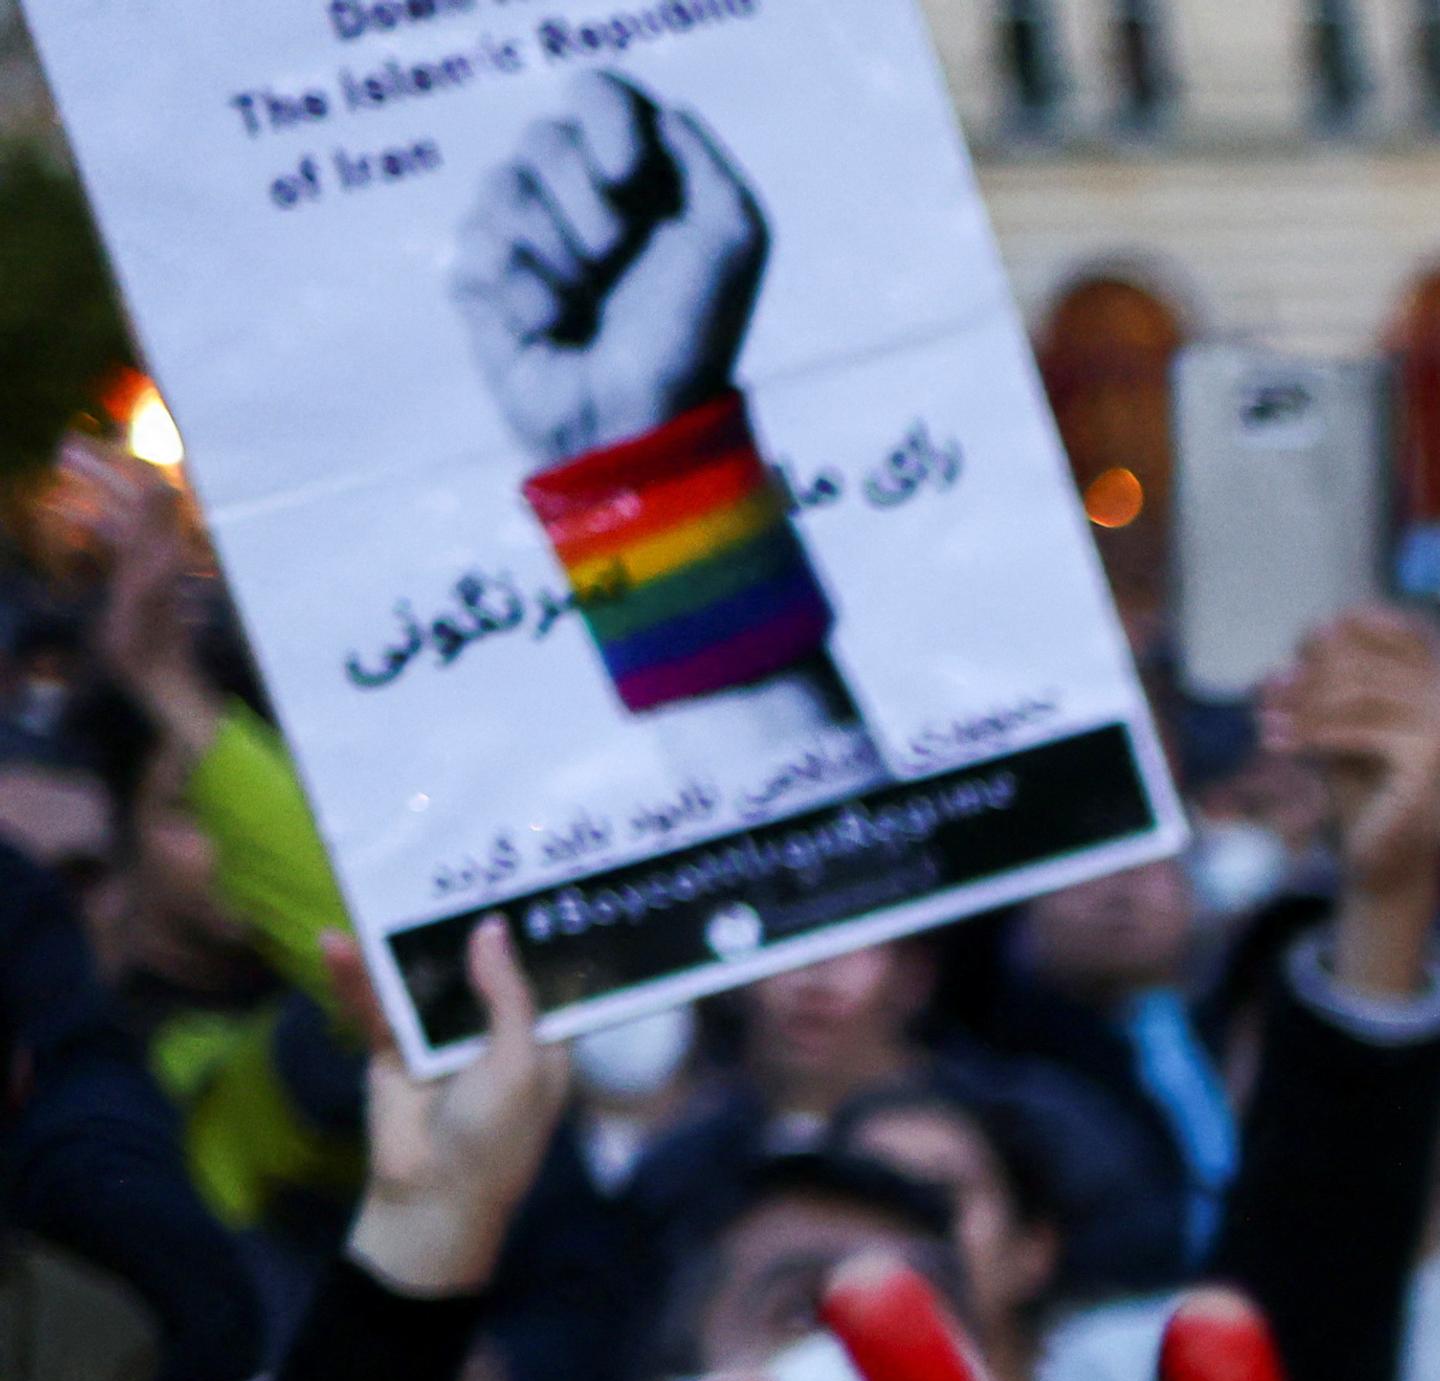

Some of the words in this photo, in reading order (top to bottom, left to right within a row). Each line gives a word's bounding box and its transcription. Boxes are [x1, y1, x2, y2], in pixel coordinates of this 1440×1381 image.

[229, 90, 329, 138] The
[333, 36, 524, 113] Islamic
[269, 152, 322, 210] of
[331, 138, 443, 192] Iran
